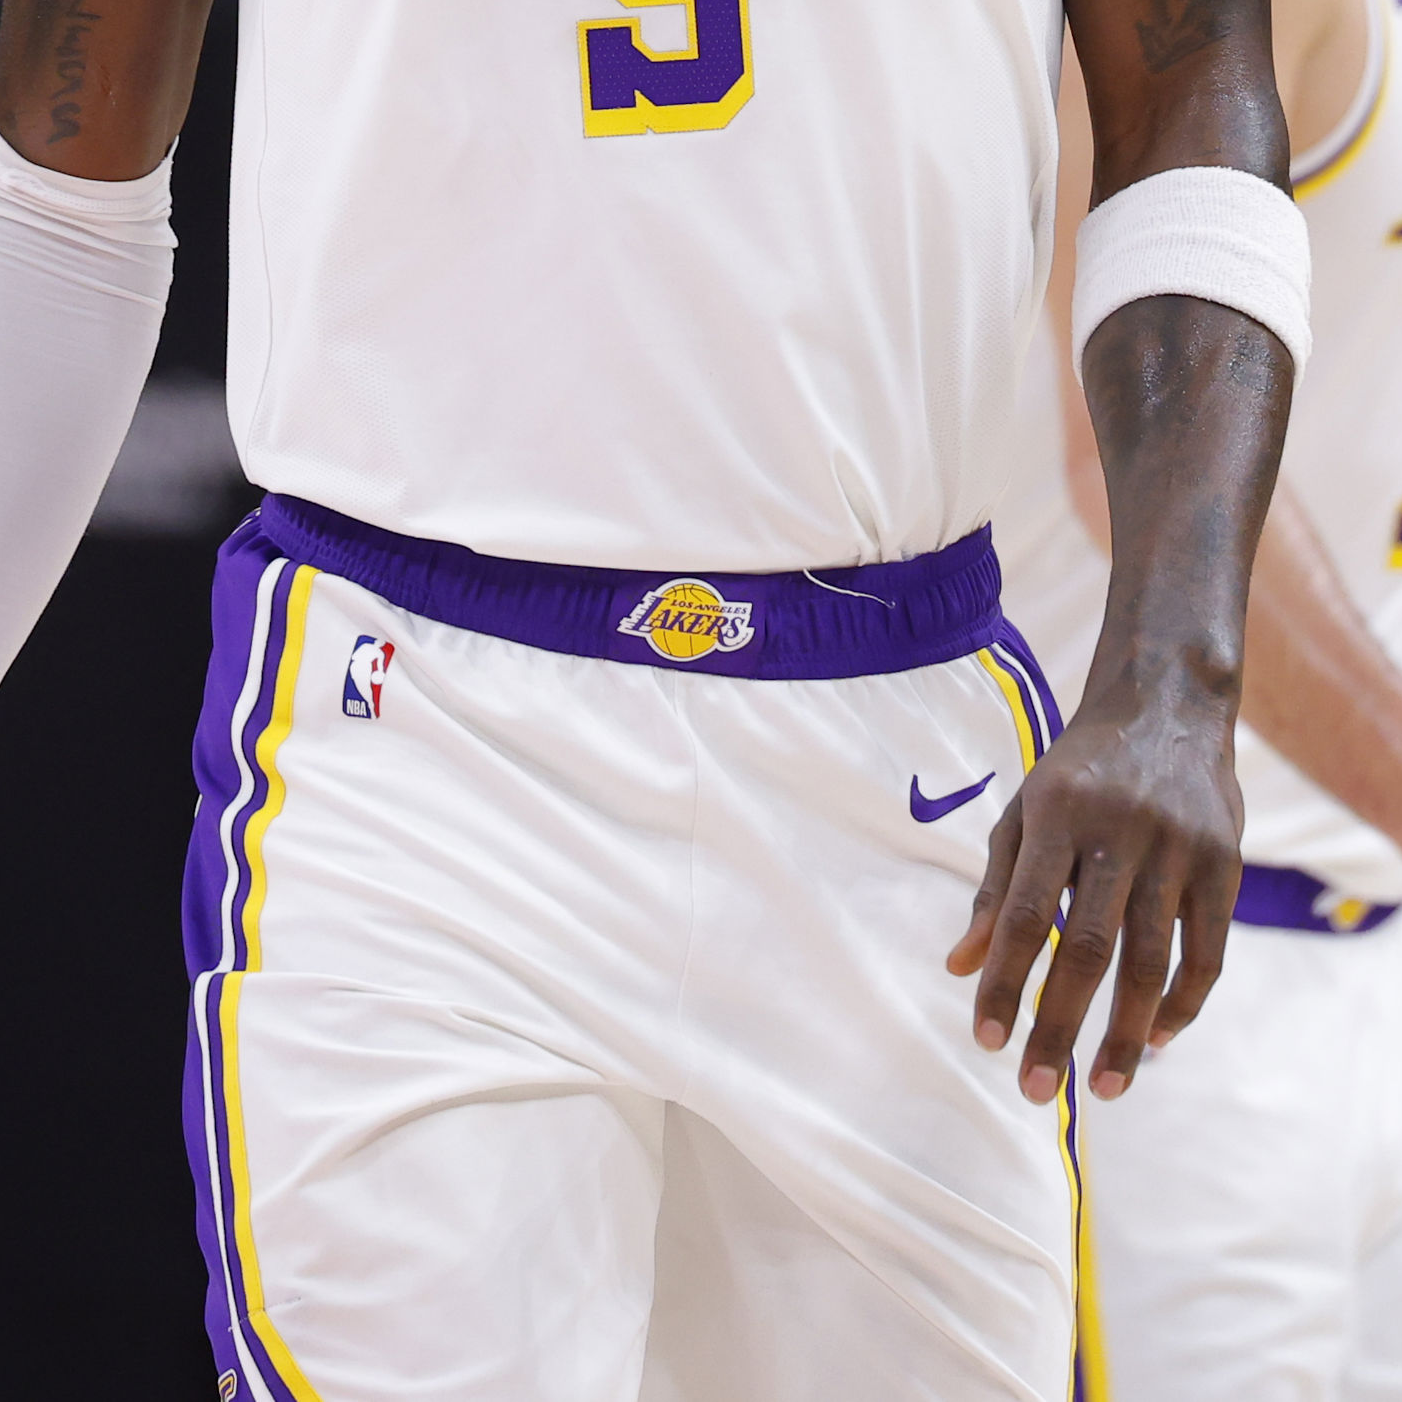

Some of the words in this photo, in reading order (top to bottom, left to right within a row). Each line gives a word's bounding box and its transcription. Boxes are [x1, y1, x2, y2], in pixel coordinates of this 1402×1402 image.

[671, 599, 693, 609] LOS
[696, 602, 747, 615] ANGELES
[625, 595, 750, 647] LAKERS
[346, 698, 368, 717] NBA
